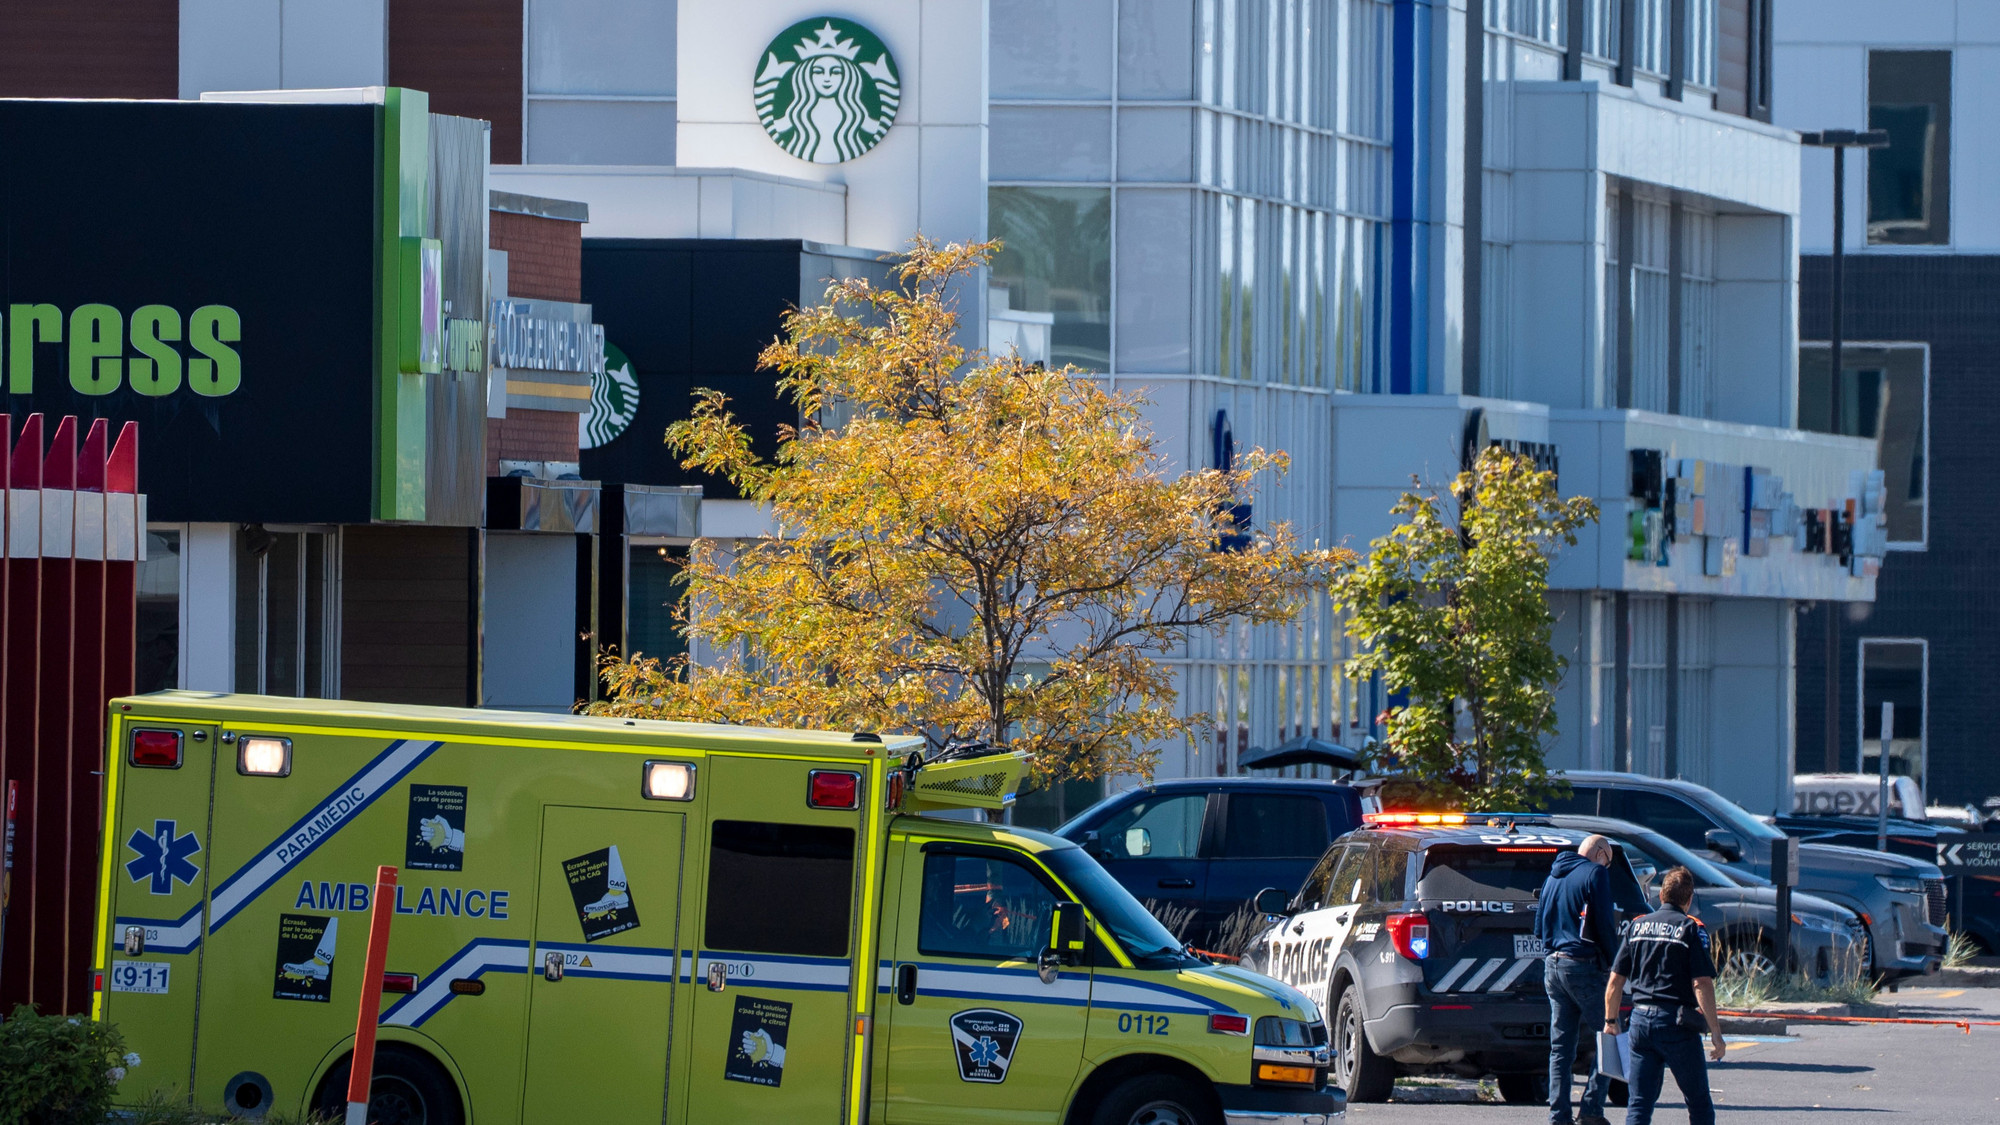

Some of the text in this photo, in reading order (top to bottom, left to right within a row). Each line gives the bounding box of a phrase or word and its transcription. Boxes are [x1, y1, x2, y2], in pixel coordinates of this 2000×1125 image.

[0, 302, 241, 396] ress
[437, 790, 464, 798] solution,
[276, 785, 365, 864] PARAMÉDIC
[1479, 835, 1572, 845] 525
[1978, 850, 1991, 858] AU
[586, 870, 601, 878] CAQ
[609, 880, 626, 888] CAQ
[294, 880, 509, 920] AMBLANCE
[1442, 900, 1514, 913] POLICE
[146, 929, 158, 941] D3
[1516, 940, 1544, 953] FRX3
[317, 948, 332, 960] CAQ
[565, 954, 578, 965] D2
[1282, 936, 1334, 987] POLICE
[727, 964, 739, 975] D1
[123, 966, 168, 988] 9-1-1
[763, 1004, 788, 1014] solution,
[765, 1011, 788, 1019] presser
[768, 1018, 786, 1026] citron
[972, 1023, 997, 1032] Québec
[1118, 1012, 1170, 1036] 0112
